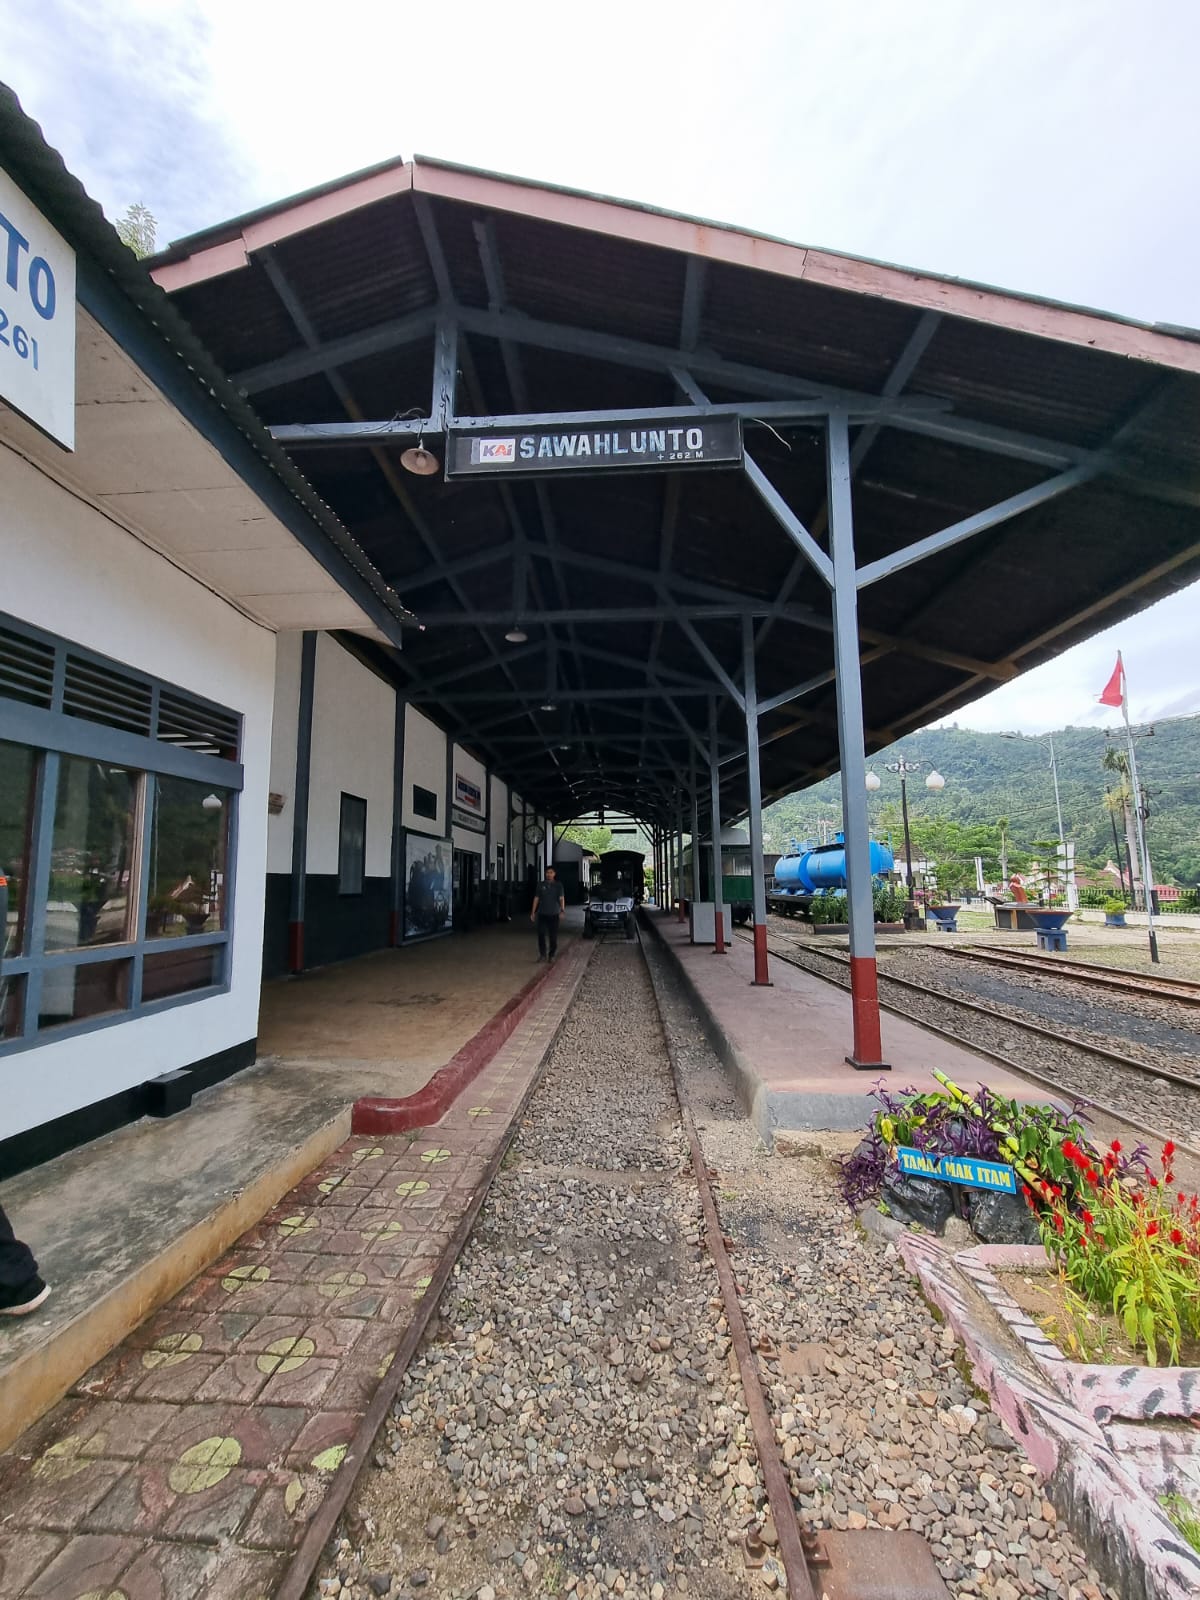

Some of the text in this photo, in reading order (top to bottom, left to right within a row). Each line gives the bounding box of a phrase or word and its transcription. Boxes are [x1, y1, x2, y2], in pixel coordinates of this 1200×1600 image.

[519, 427, 703, 459] SAWAHLUNTO
[669, 451, 691, 460] 262
[695, 450, 703, 459] M
[945, 1161, 974, 1180] MAK
[977, 1166, 1011, 1187] ITAM
